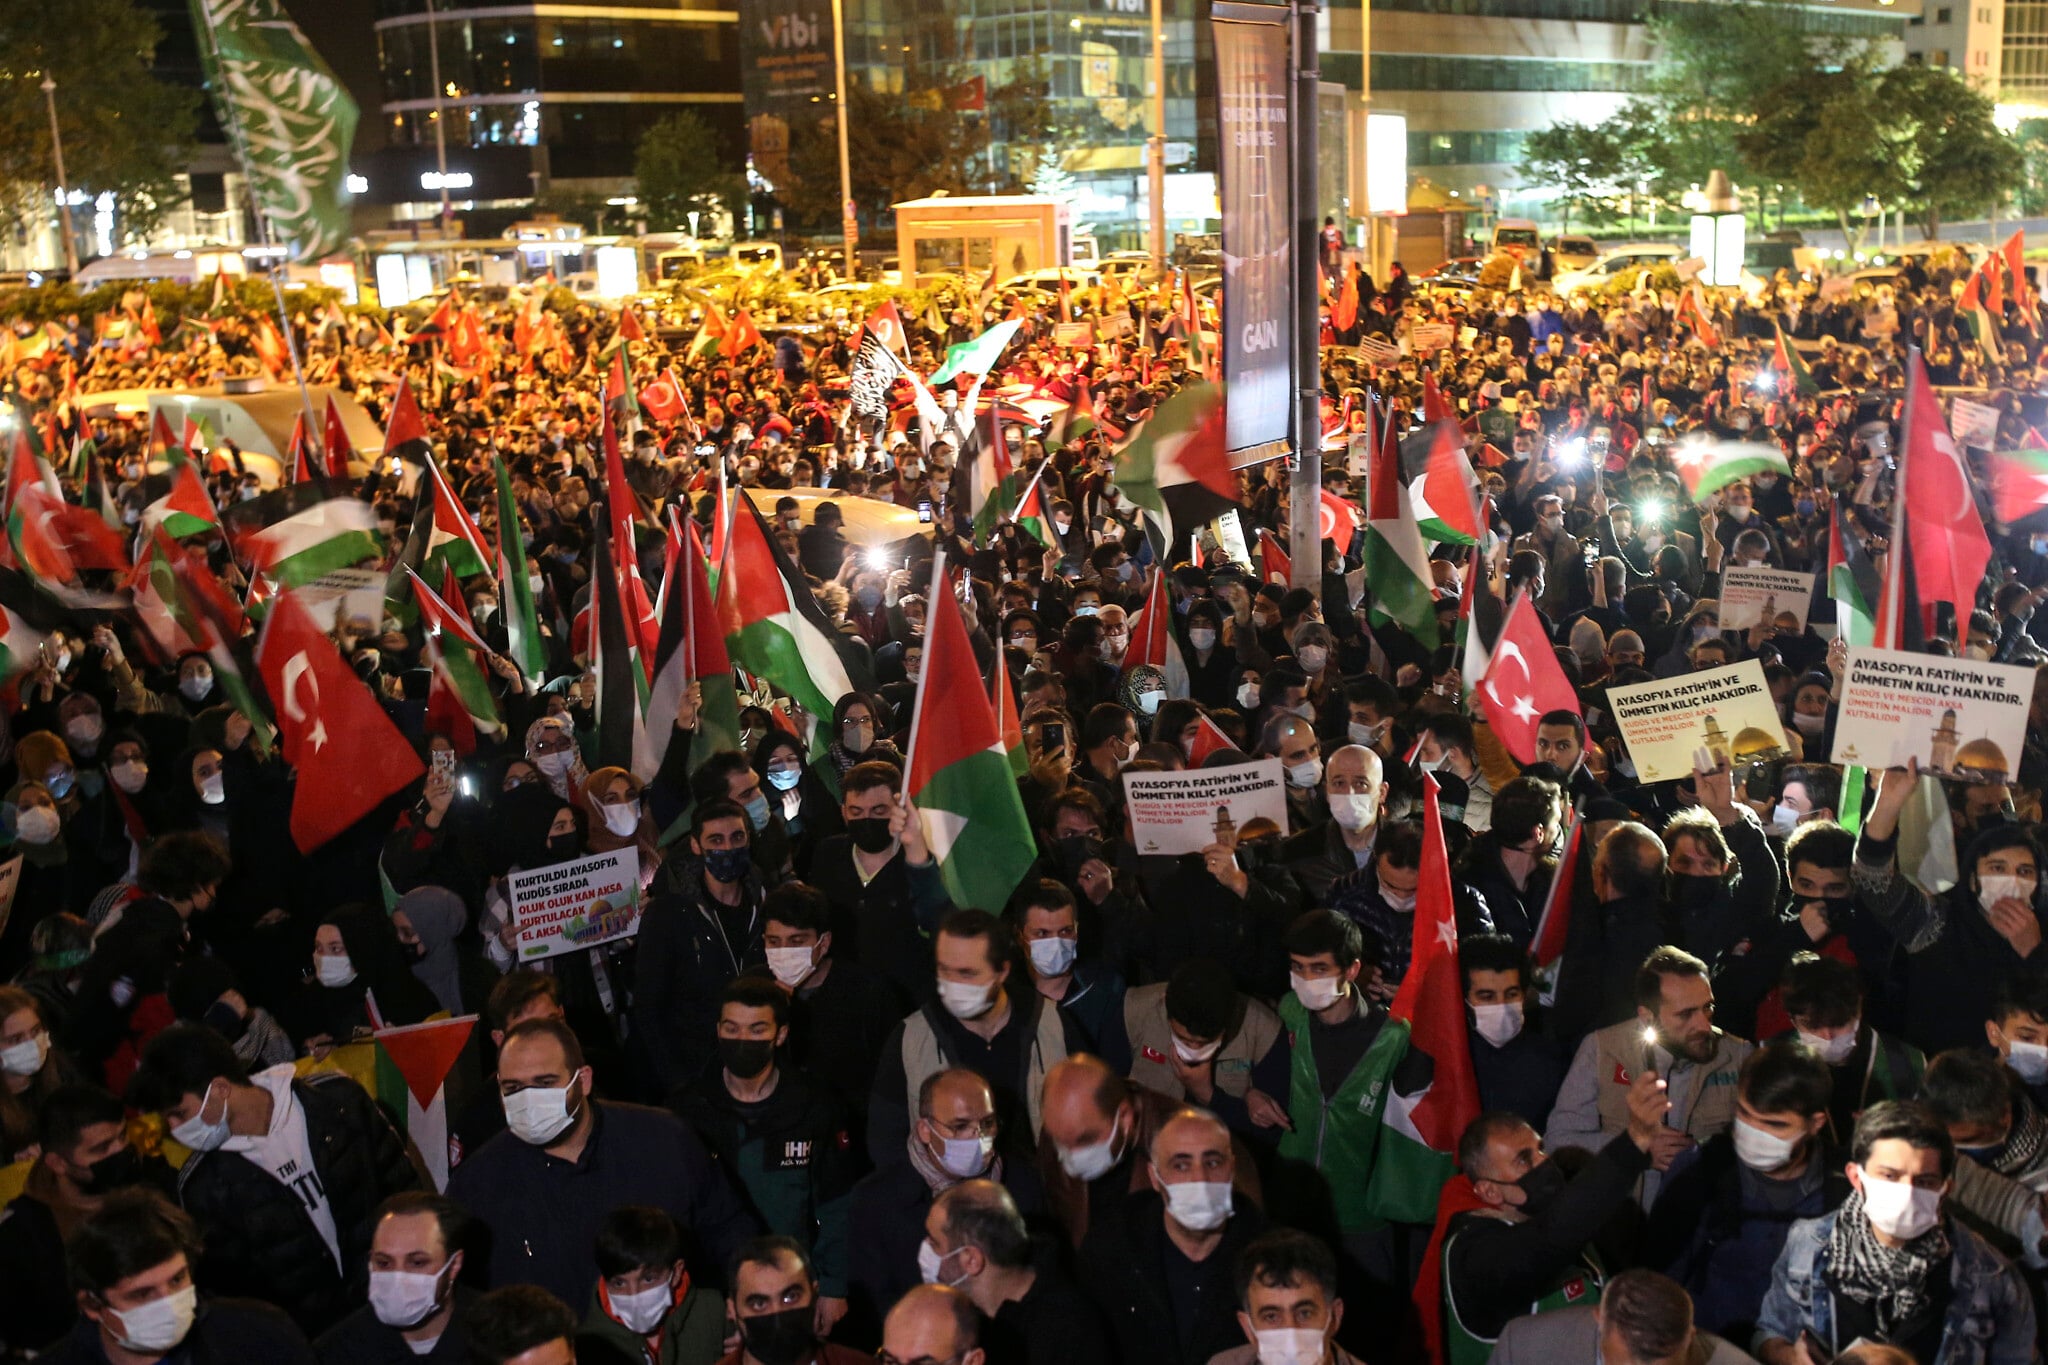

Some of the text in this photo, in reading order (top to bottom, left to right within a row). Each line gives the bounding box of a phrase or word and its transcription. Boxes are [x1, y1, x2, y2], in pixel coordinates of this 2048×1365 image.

[761, 12, 818, 48] Vibi
[1854, 658, 1923, 676] AYASOFYA
[1987, 676, 2006, 688] VE
[1616, 690, 1672, 707] AYASOFYA
[1723, 675, 1740, 686] VE
[1619, 684, 1762, 718] ÜMMETİN KILIÇ HAKKIDIR.
[1849, 688, 1880, 698] KUDÜS
[1884, 692, 1895, 700] VE
[1851, 672, 2024, 706] ÜMMETİN KILIÇ HAKKIDIR.
[1651, 716, 1660, 724] VE
[1130, 780, 1191, 789] AYASOFYA
[1244, 771, 1260, 780] VE
[1132, 779, 1279, 800] ÜMMETİN KILIÇ HAKKIDIR.
[515, 856, 618, 889] KURTULDU AYASOFYA
[516, 877, 590, 902] KUDÜS SIRADA
[518, 882, 622, 915] OLUK OLUK KAN AKSA
[519, 905, 586, 927] KURTULACAK
[522, 924, 564, 942] EL AKSA
